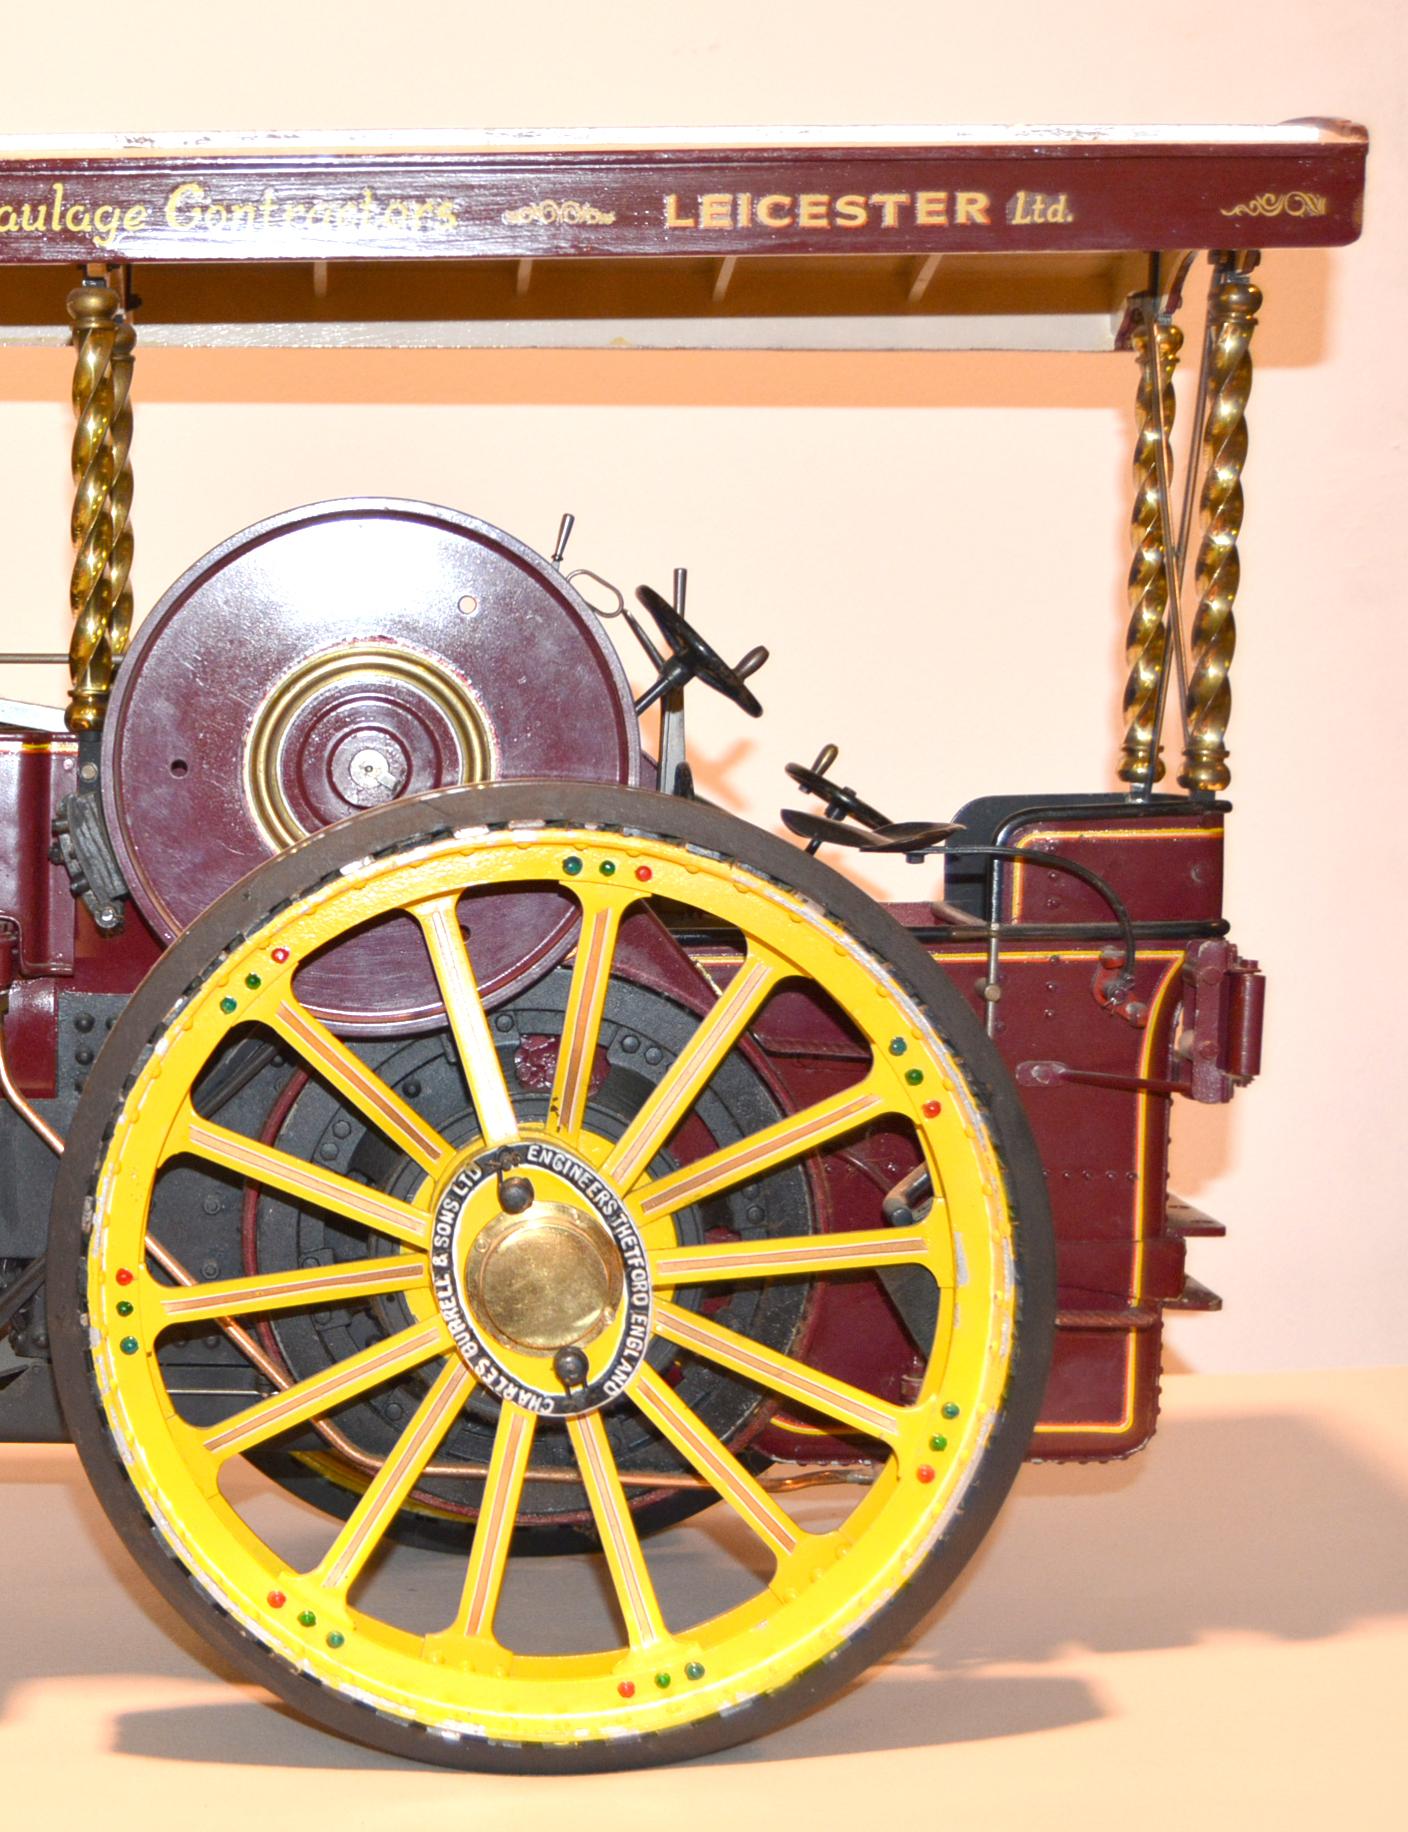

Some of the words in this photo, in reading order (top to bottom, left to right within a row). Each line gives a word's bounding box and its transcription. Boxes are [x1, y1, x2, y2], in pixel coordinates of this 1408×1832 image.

[663, 190, 991, 229] LEICESTER
[1011, 190, 1074, 226] Ltd.
[452, 1161, 483, 1196] LTD
[527, 1145, 618, 1216] ENGINEERS
[434, 1198, 460, 1248] SONS
[432, 1252, 450, 1267] &
[611, 1213, 649, 1307] THETFORD
[434, 1273, 479, 1358] BURRELL
[602, 1313, 648, 1397] ENGLAND
[474, 1358, 555, 1414] CHARLES
